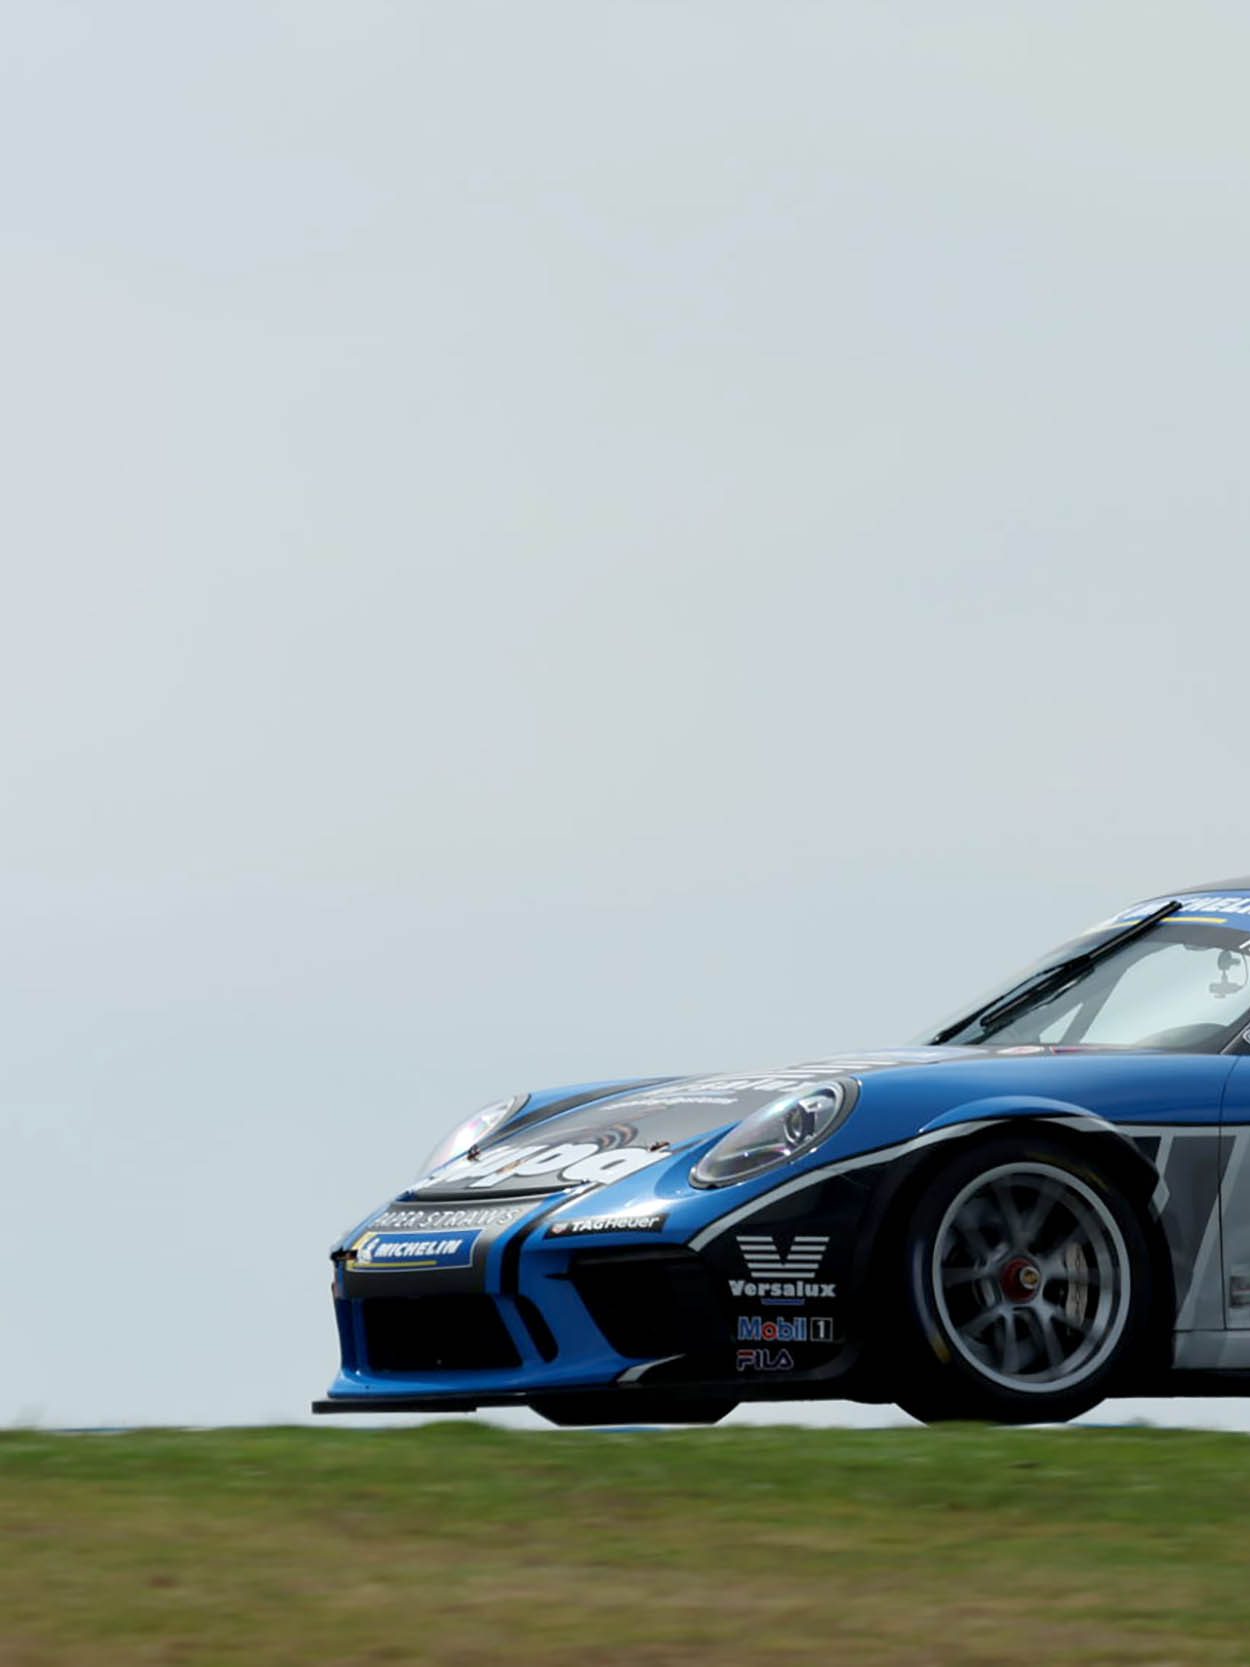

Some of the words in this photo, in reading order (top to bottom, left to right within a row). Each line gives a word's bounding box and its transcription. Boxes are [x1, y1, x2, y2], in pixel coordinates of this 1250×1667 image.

[373, 1239, 463, 1258] MICHELIN
[728, 1280, 837, 1298] Versalux
[737, 1316, 807, 1342] Mobil
[737, 1349, 794, 1372] FILA
